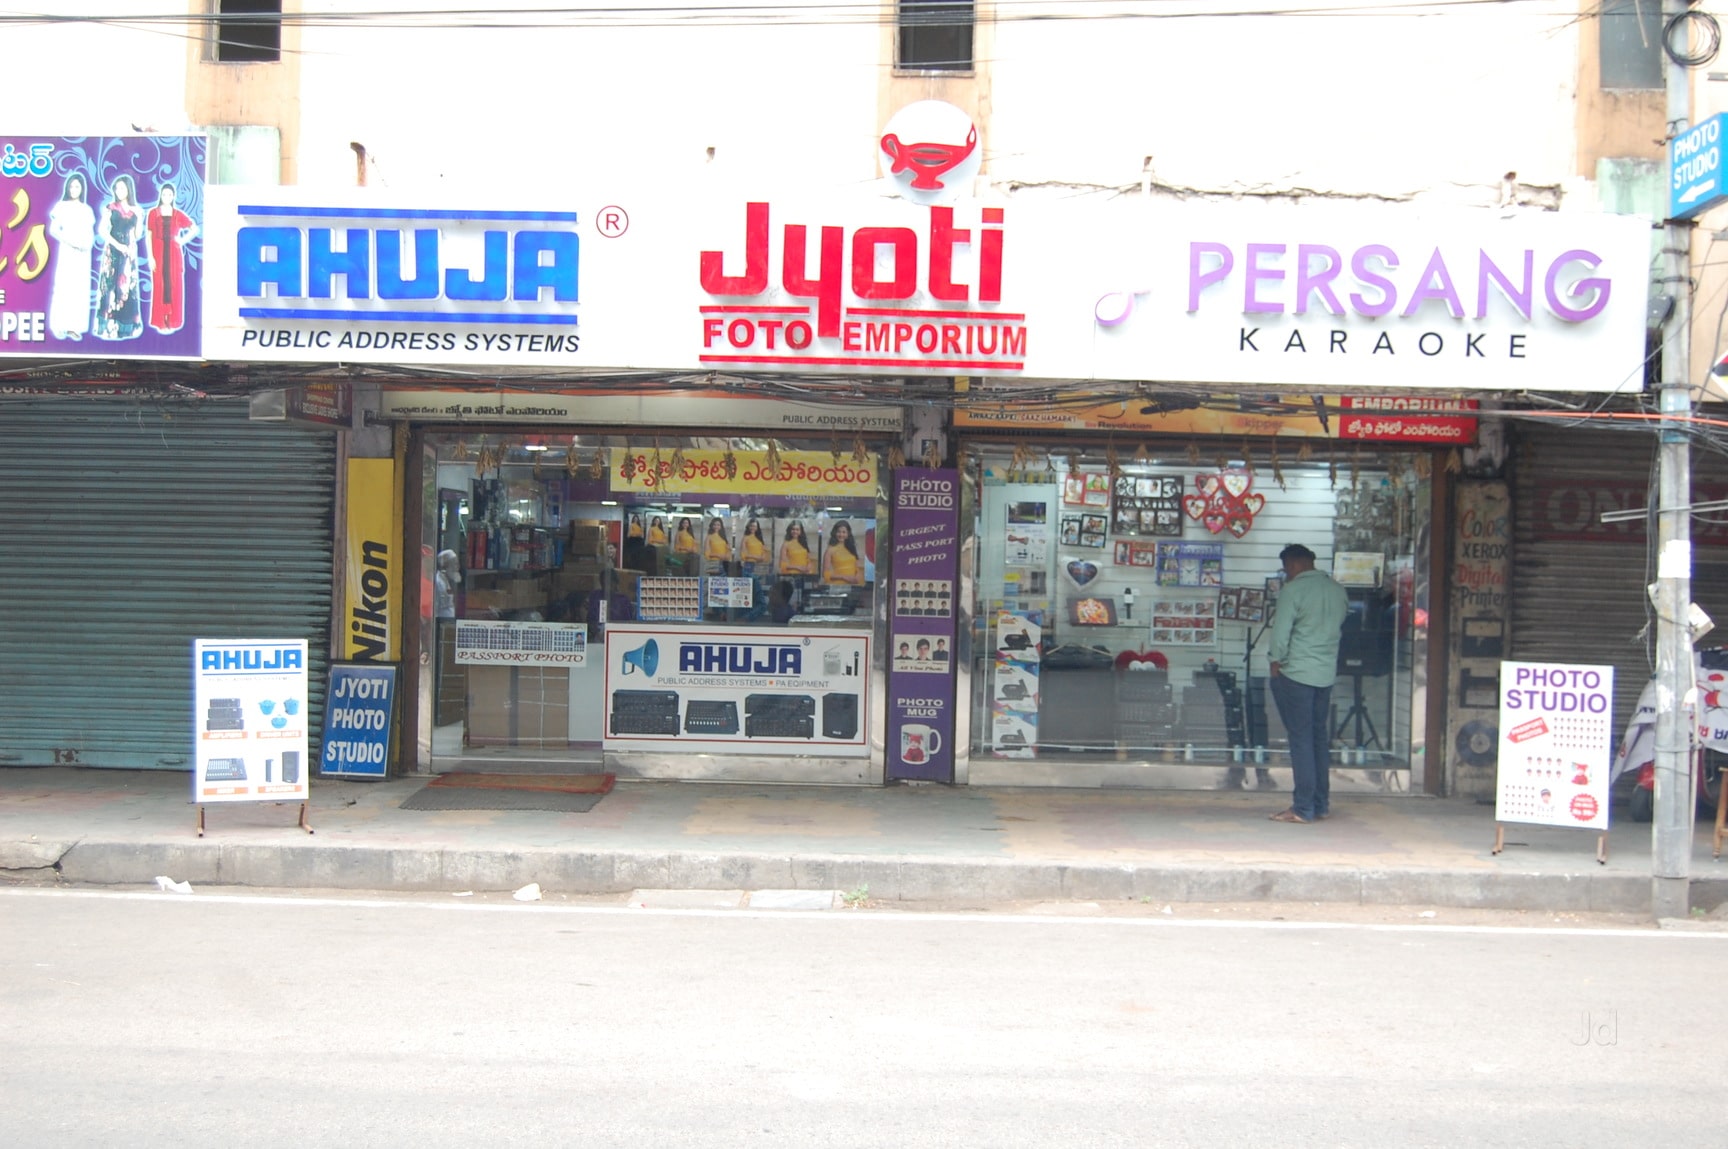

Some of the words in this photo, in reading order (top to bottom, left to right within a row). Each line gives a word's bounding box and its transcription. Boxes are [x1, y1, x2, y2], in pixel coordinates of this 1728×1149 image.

[1674, 119, 1720, 163] PHOTO
[1673, 147, 1719, 189] STUDIO
[237, 226, 580, 301] AHUJA
[700, 201, 1004, 337] Jyoti
[1187, 241, 1612, 323] PERSANG
[0, 311, 45, 341] PEE
[703, 318, 813, 350] FOTO
[844, 322, 1026, 356] EMPORIUM
[242, 329, 331, 349] PUBLIC
[337, 331, 456, 351] ADDRESS
[464, 334, 579, 353] SYSTEMS
[1240, 327, 1527, 358] KARAOKE
[782, 415, 814, 424] PUBLIC
[816, 416, 858, 425] ADDRESS
[861, 417, 900, 427] SYSTEMS
[900, 479, 952, 493] PHOTO
[898, 494, 953, 507] STUDIO
[900, 523, 947, 537] URGENT
[896, 541, 923, 553] PASS
[925, 537, 955, 548] PORT
[1462, 542, 1509, 559] XEROX
[907, 552, 947, 565] PHOTO
[1457, 563, 1505, 591] Digital
[352, 540, 388, 661] Nikon
[202, 650, 302, 670] AHUJA
[457, 651, 533, 662] PASSPORT
[534, 653, 584, 663] PHOTO
[680, 645, 802, 674] AHUJA
[335, 677, 389, 700] JYOTI
[657, 677, 687, 686] PUBLIC
[688, 678, 727, 686] ADDRESS
[729, 679, 767, 687] SYSTEMS
[1516, 667, 1601, 689] PHOTO
[897, 697, 944, 707] PHOTO
[906, 708, 938, 717] MUG
[1506, 689, 1607, 713] STUDIO
[332, 708, 386, 731] PHOTO
[326, 740, 385, 764] STUDIO
